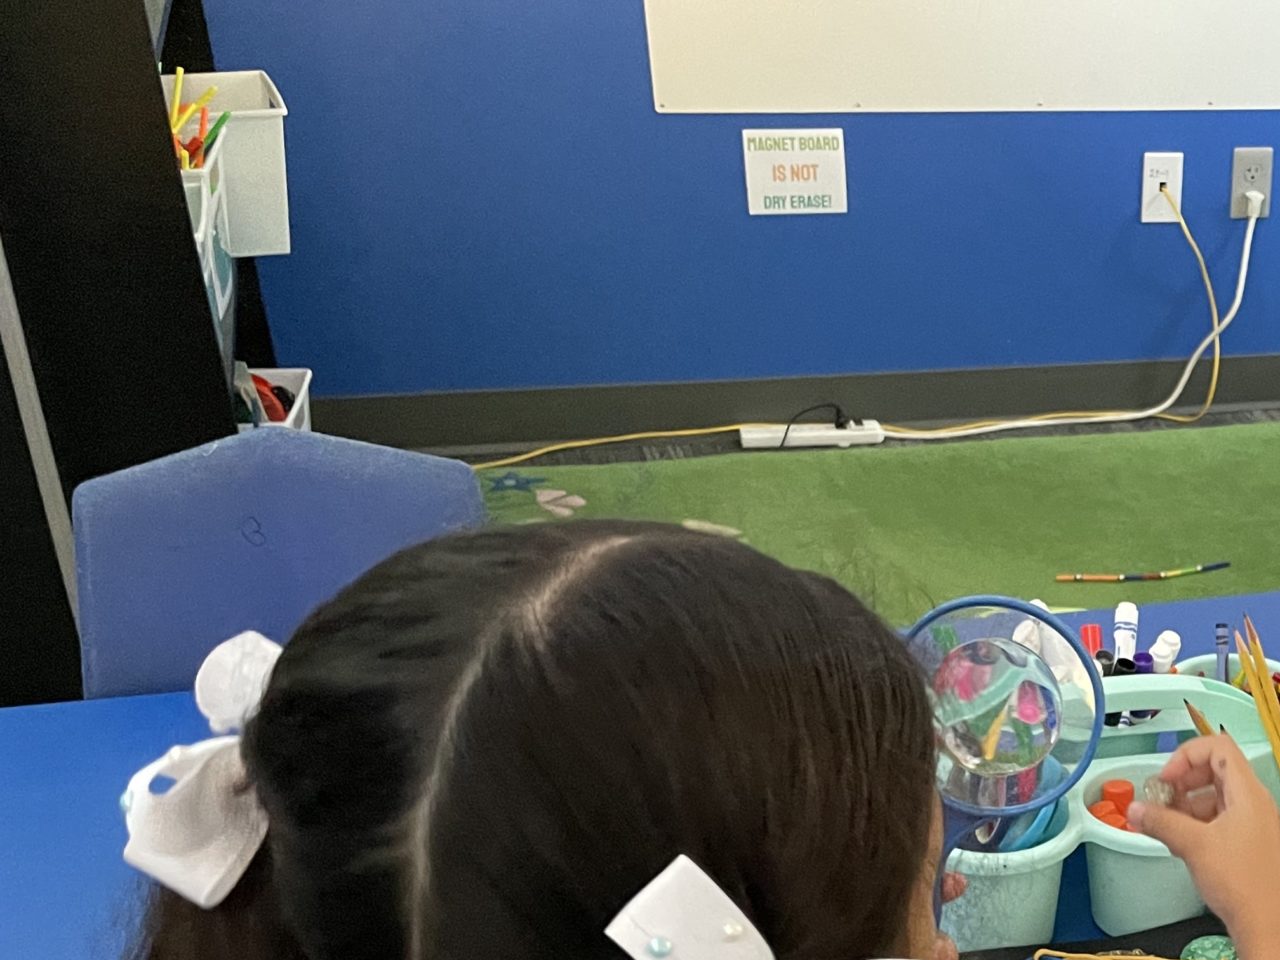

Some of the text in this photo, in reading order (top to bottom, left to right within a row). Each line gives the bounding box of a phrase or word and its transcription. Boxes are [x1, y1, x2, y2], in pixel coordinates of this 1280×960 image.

[747, 136, 840, 152] MAGNET BOARD
[772, 164, 819, 182] IS NOT
[763, 194, 832, 209] DRY ERASE!
